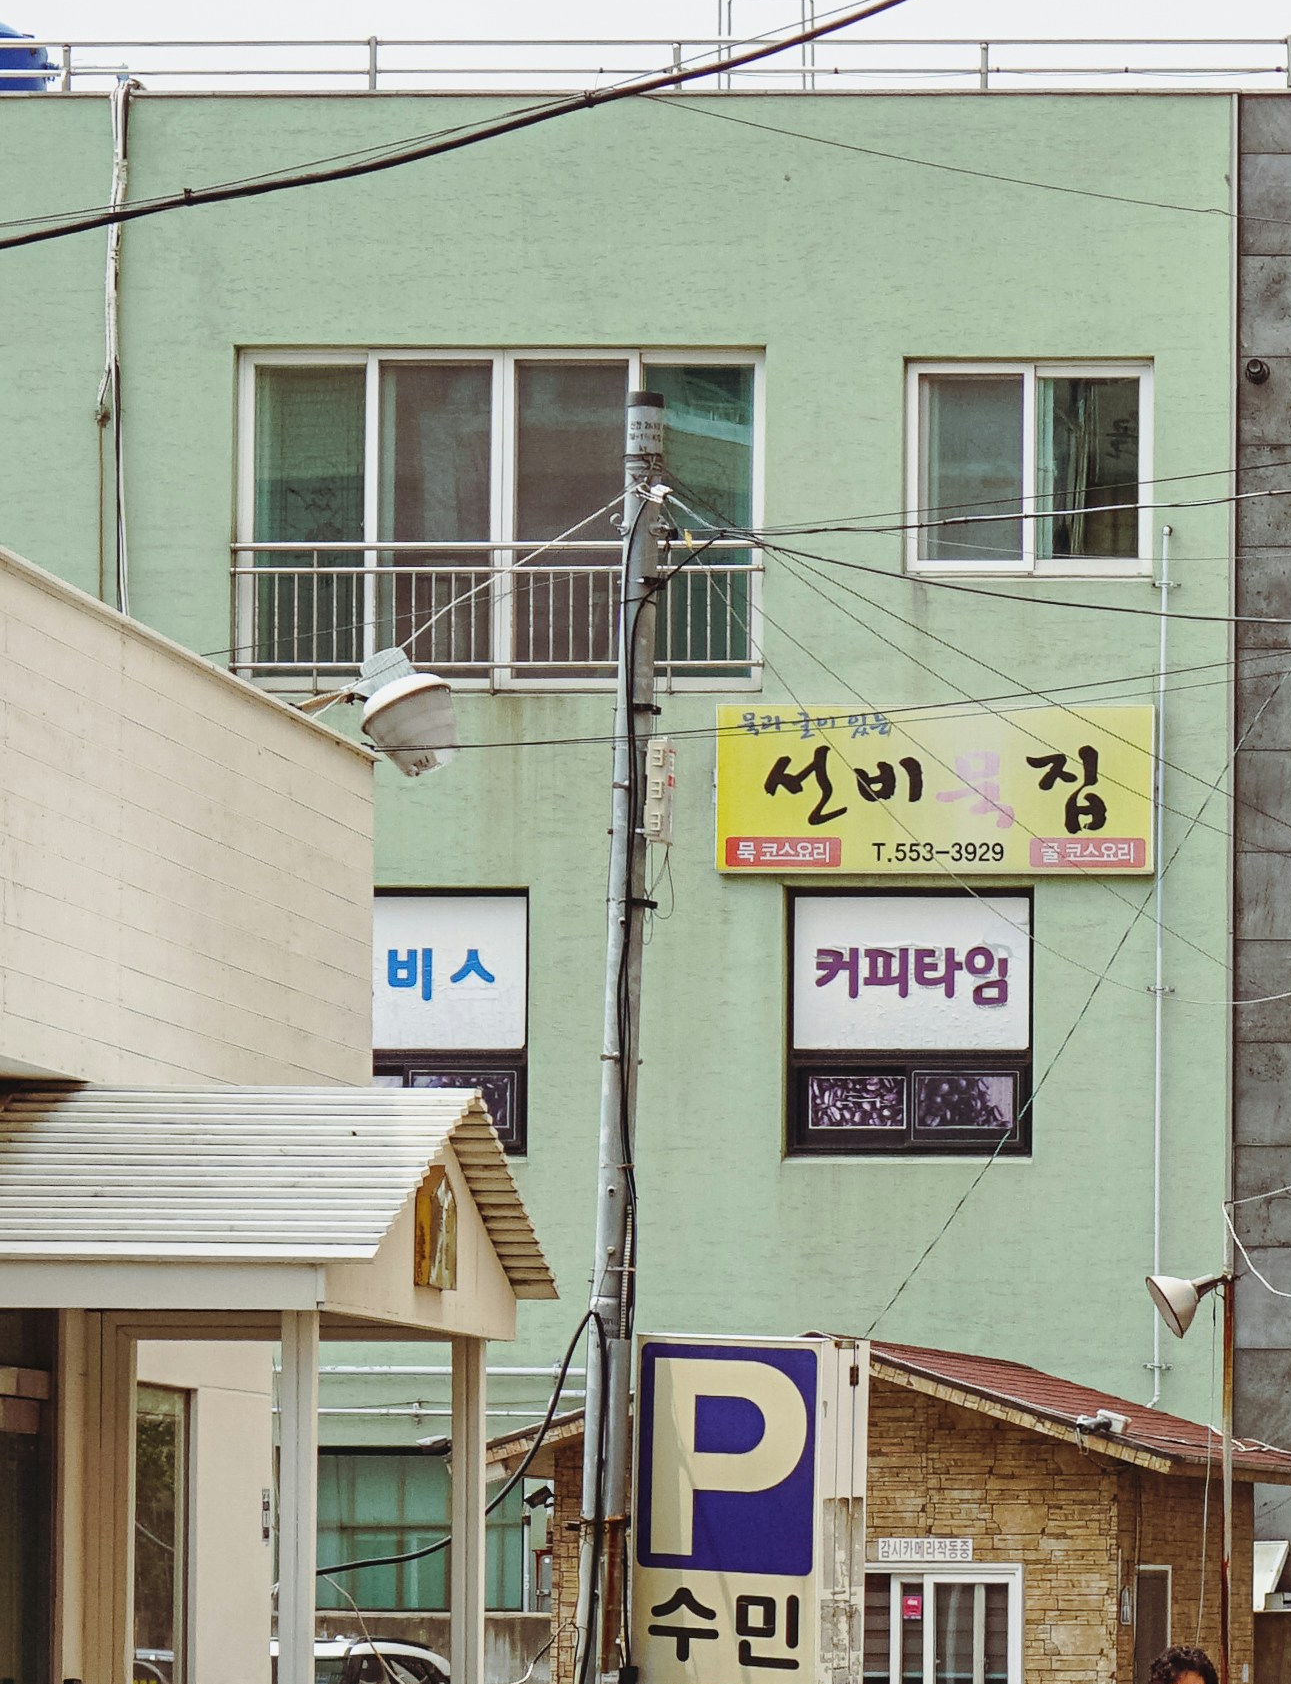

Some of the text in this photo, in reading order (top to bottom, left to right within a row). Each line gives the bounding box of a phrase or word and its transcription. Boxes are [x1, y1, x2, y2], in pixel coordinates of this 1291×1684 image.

[736, 841, 831, 864] 묵 코스요리
[872, 842, 1005, 864] T.553-3929
[1065, 841, 1135, 863] 코스요리
[815, 946, 1009, 1006] 커피타임
[650, 1357, 808, 1557] P
[881, 1540, 970, 1559] 감시카메라작동중
[647, 1586, 800, 1670] 수민
